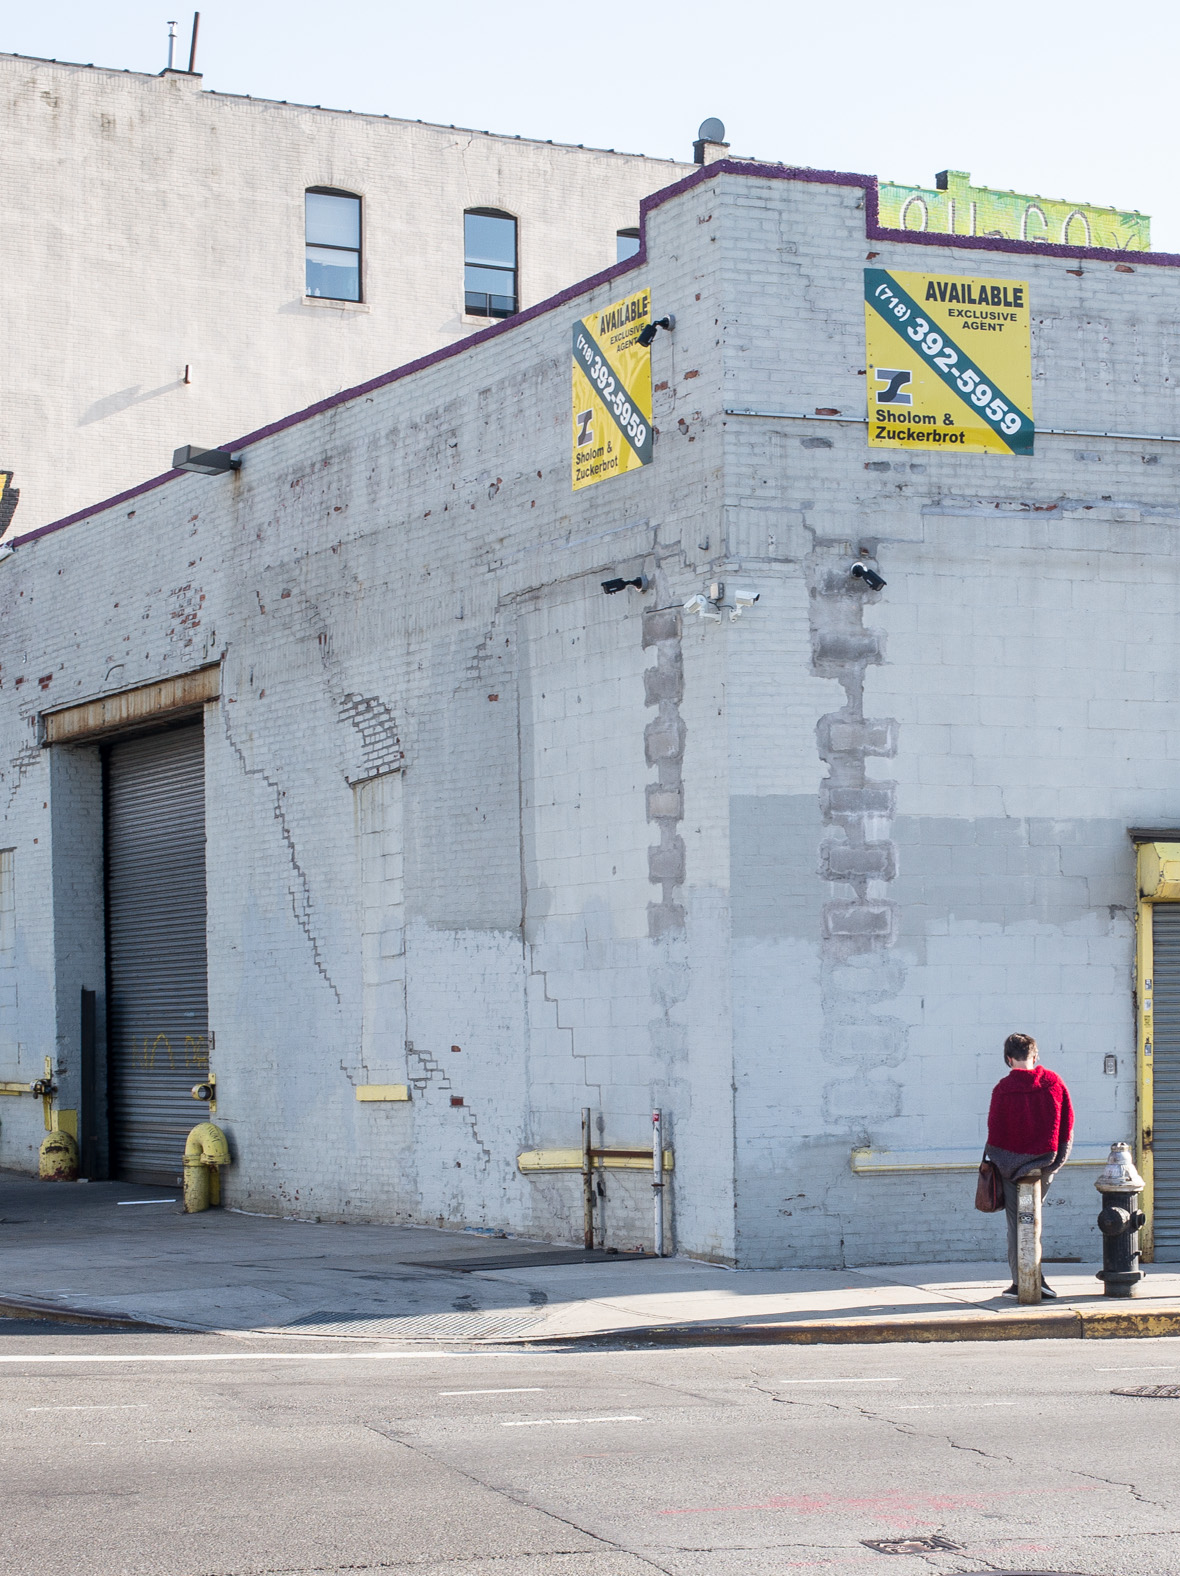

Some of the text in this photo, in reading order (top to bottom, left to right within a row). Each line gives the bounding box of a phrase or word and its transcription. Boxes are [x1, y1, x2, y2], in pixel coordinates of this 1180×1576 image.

[925, 281, 1024, 308] AVAILABLE
[600, 295, 648, 336] AVAILABLE
[948, 308, 1017, 322] EXCLUSIVE
[962, 321, 1005, 332] AGENT
[610, 322, 645, 345] EXCLUSIVE
[617, 337, 638, 353] AGENT
[875, 284, 1022, 435] (718) 392-5959
[576, 333, 647, 448] (718) 392-5959
[876, 409, 955, 426] Sholom &
[875, 425, 966, 444] Zuckerbrot
[575, 440, 613, 465] Sholom &
[575, 455, 618, 481] Zuckerbrot
